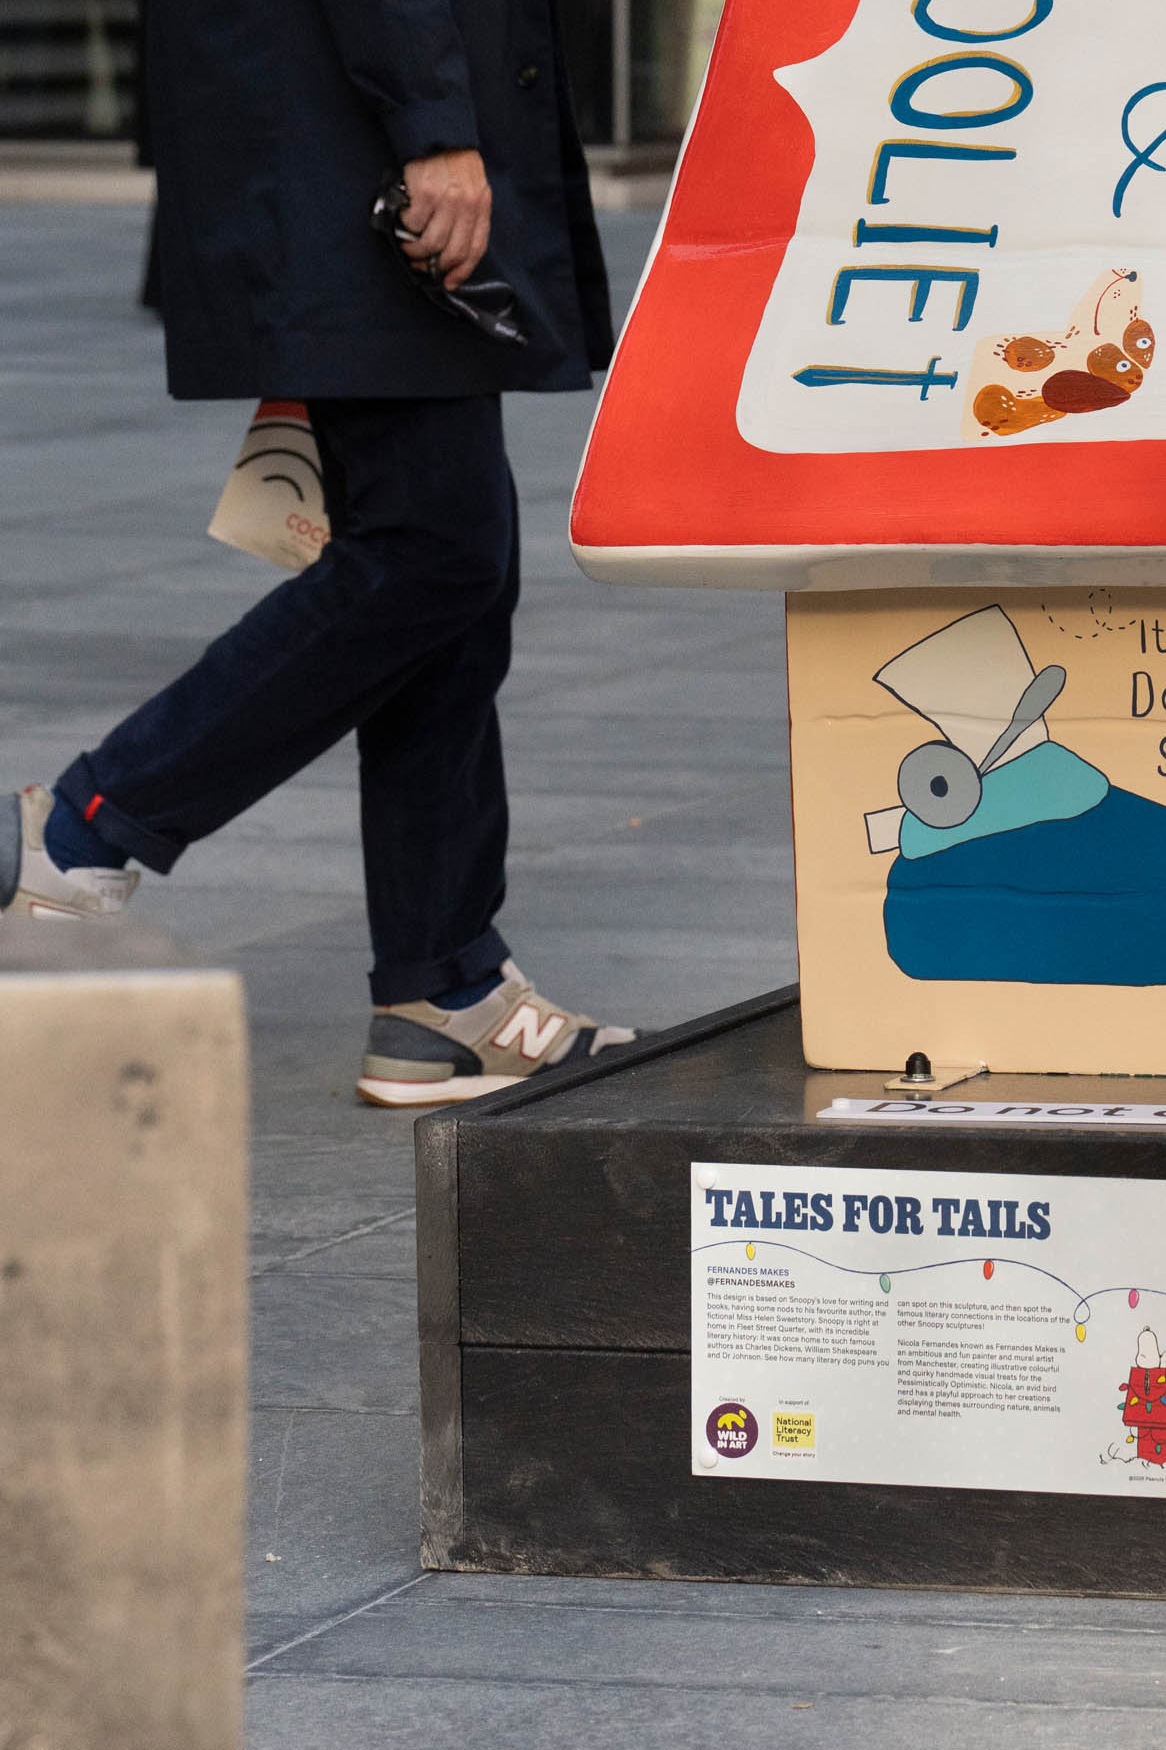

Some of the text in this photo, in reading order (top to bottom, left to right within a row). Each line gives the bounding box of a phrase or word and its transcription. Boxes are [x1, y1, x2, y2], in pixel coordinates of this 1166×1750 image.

[491, 1002, 567, 1060] N
[865, 1102, 975, 1114] Do
[996, 1106, 1132, 1117] not
[706, 1189, 1051, 1240] TALES FOR TAILS
[707, 1265, 790, 1277] FERNANDES MAKES
[707, 1276, 795, 1289] @FERNANDESMAKES
[723, 1294, 746, 1303] design
[789, 1297, 821, 1306] Snoopy's
[849, 1300, 873, 1308] writing
[707, 1303, 730, 1312] books,
[732, 1304, 754, 1313] having
[849, 1309, 873, 1318] author,
[912, 1301, 927, 1309] spot
[954, 1303, 989, 1312] sculpture,
[1023, 1306, 1039, 1314] spot
[707, 1312, 734, 1320] fictional
[776, 1316, 816, 1325] Sweetstory.
[818, 1317, 844, 1326] Snoopy
[854, 1319, 870, 1327] right
[924, 1311, 948, 1320] literary
[1017, 1315, 1049, 1323] locations
[778, 1325, 806, 1335] Quarter,
[835, 1328, 869, 1336] incredible
[918, 1321, 944, 1330] Snoopy
[946, 1322, 985, 1331] sculptures!
[707, 1332, 731, 1341] literary
[733, 1333, 758, 1342] history:
[849, 1338, 875, 1346] famous
[774, 1345, 802, 1354] Dickens,
[832, 1347, 877, 1357] Shakespeare
[960, 1342, 983, 1350] known
[995, 1344, 1032, 1352] Fernandes
[795, 1357, 815, 1365] many
[817, 1357, 840, 1366] literary
[842, 1358, 856, 1366] dog
[776, 1417, 812, 1427] National
[717, 1430, 747, 1441] WILD
[776, 1426, 811, 1436] Literacy
[776, 1434, 799, 1443] Trust
[717, 1441, 747, 1449] IN ART
